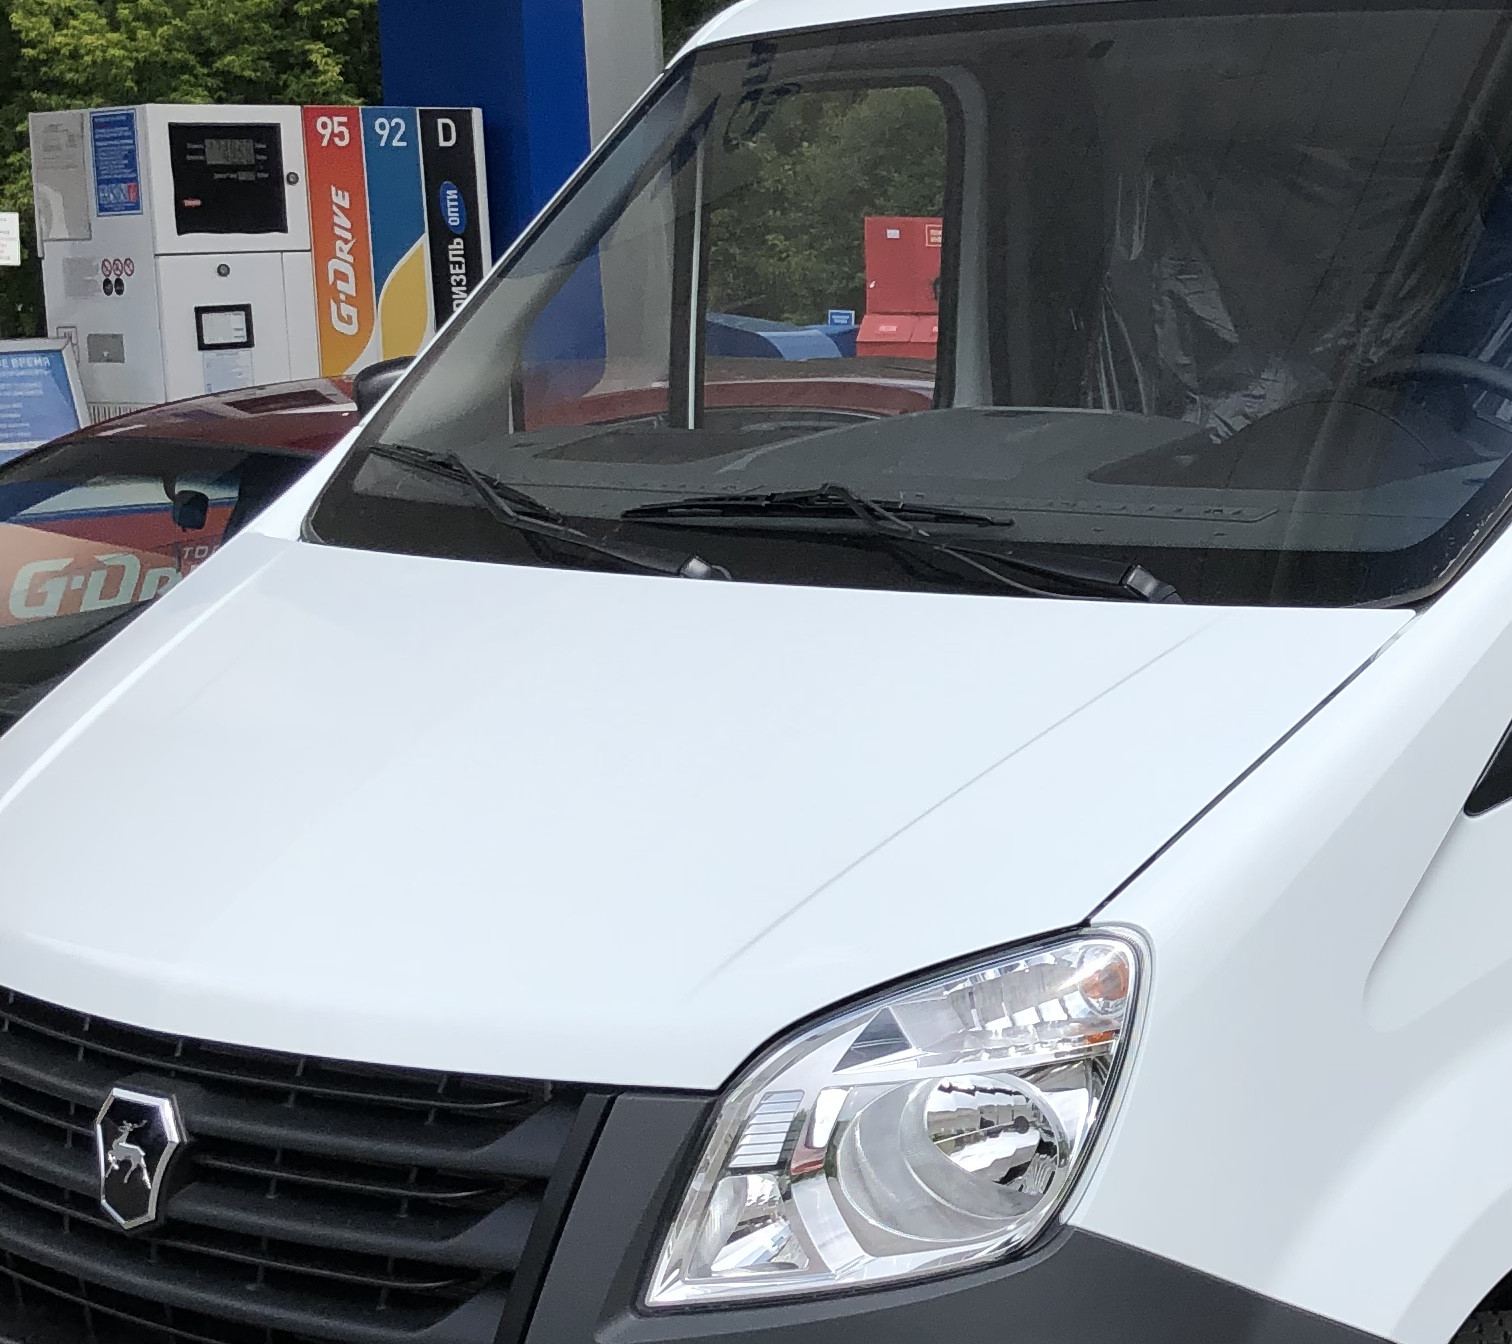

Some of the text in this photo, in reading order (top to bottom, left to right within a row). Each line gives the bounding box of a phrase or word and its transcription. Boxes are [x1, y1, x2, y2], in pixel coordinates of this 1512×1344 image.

[316, 116, 350, 147] 95
[374, 117, 408, 147] 92
[437, 118, 457, 147] D
[446, 189, 460, 226] ОПТИ
